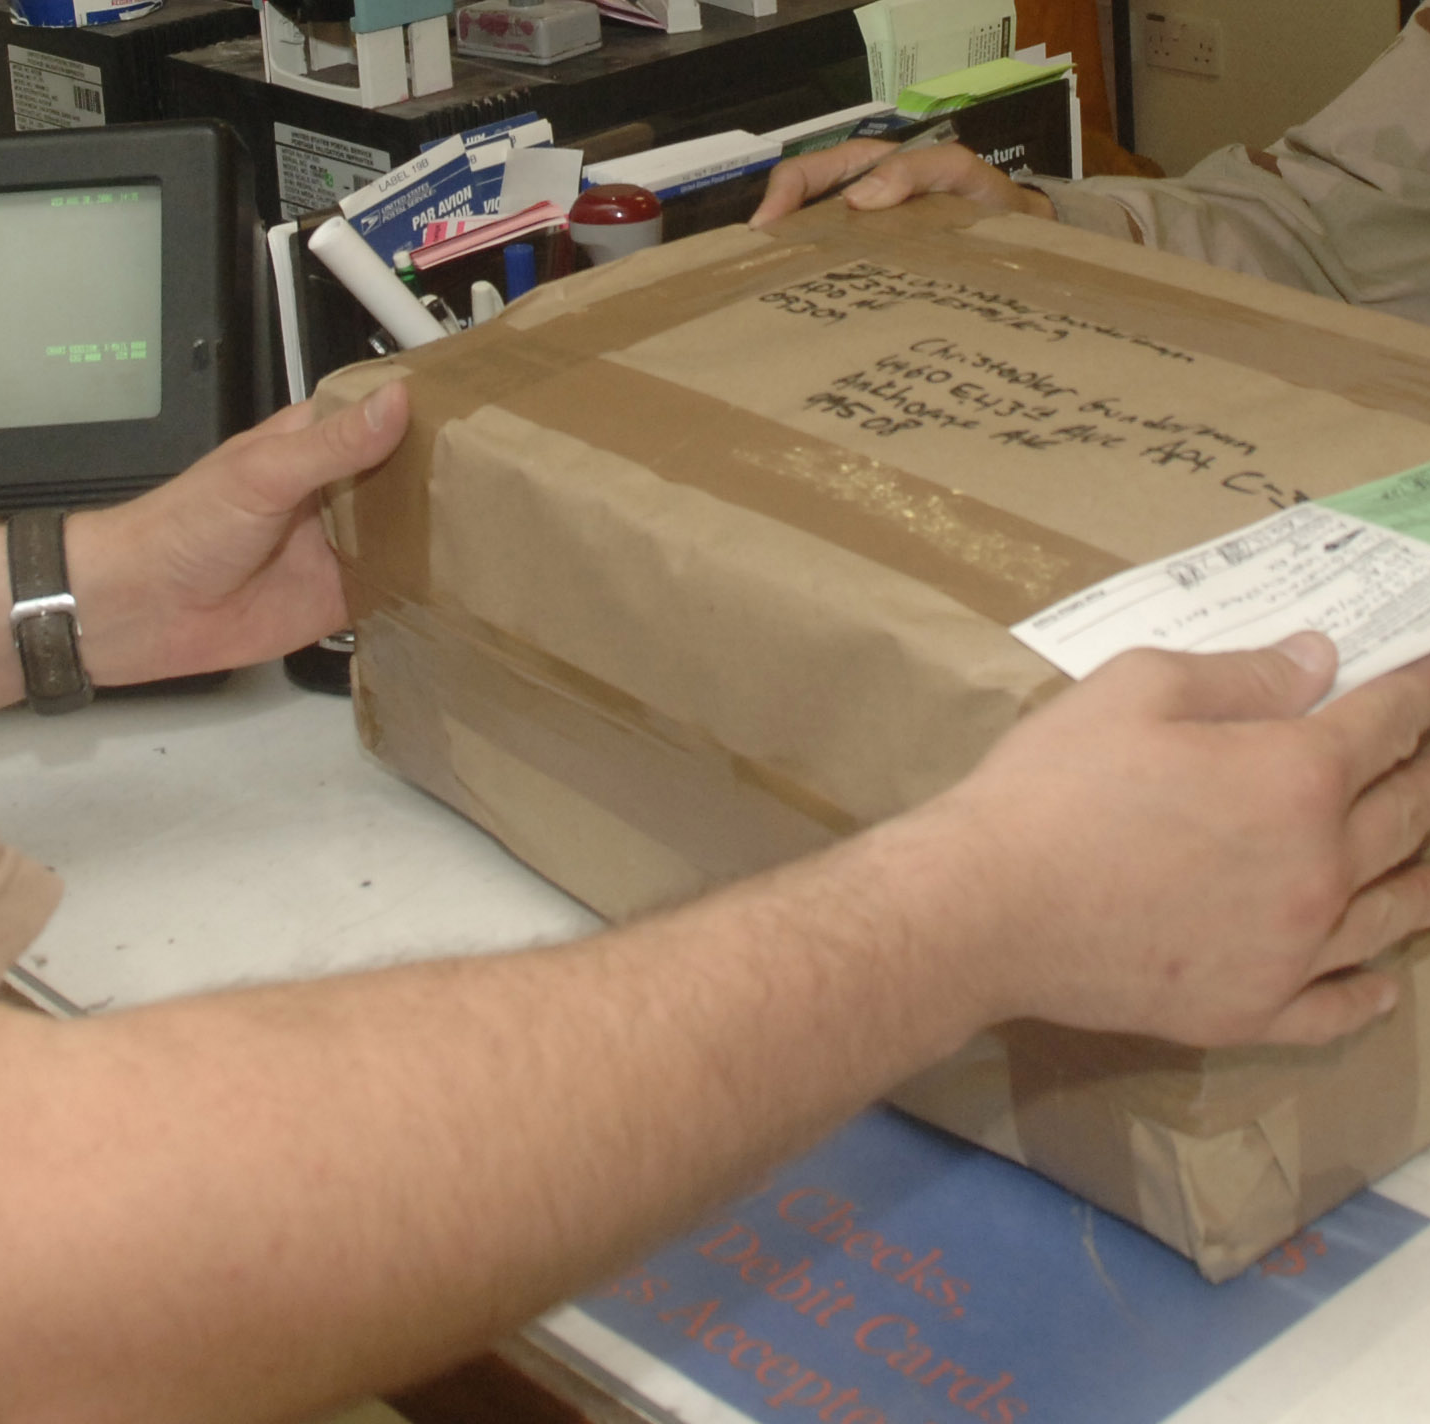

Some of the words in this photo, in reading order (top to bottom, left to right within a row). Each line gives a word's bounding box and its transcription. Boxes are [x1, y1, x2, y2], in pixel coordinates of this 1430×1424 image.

[378, 173, 410, 192] LABEL
[411, 158, 429, 174] 19B
[412, 209, 437, 231] PAR
[437, 185, 472, 215] AVION
[778, 1187, 971, 1321] Checks,
[658, 1300, 889, 1424] Accepte
[697, 1223, 855, 1329] Debit
[854, 1313, 1029, 1424] Cards
